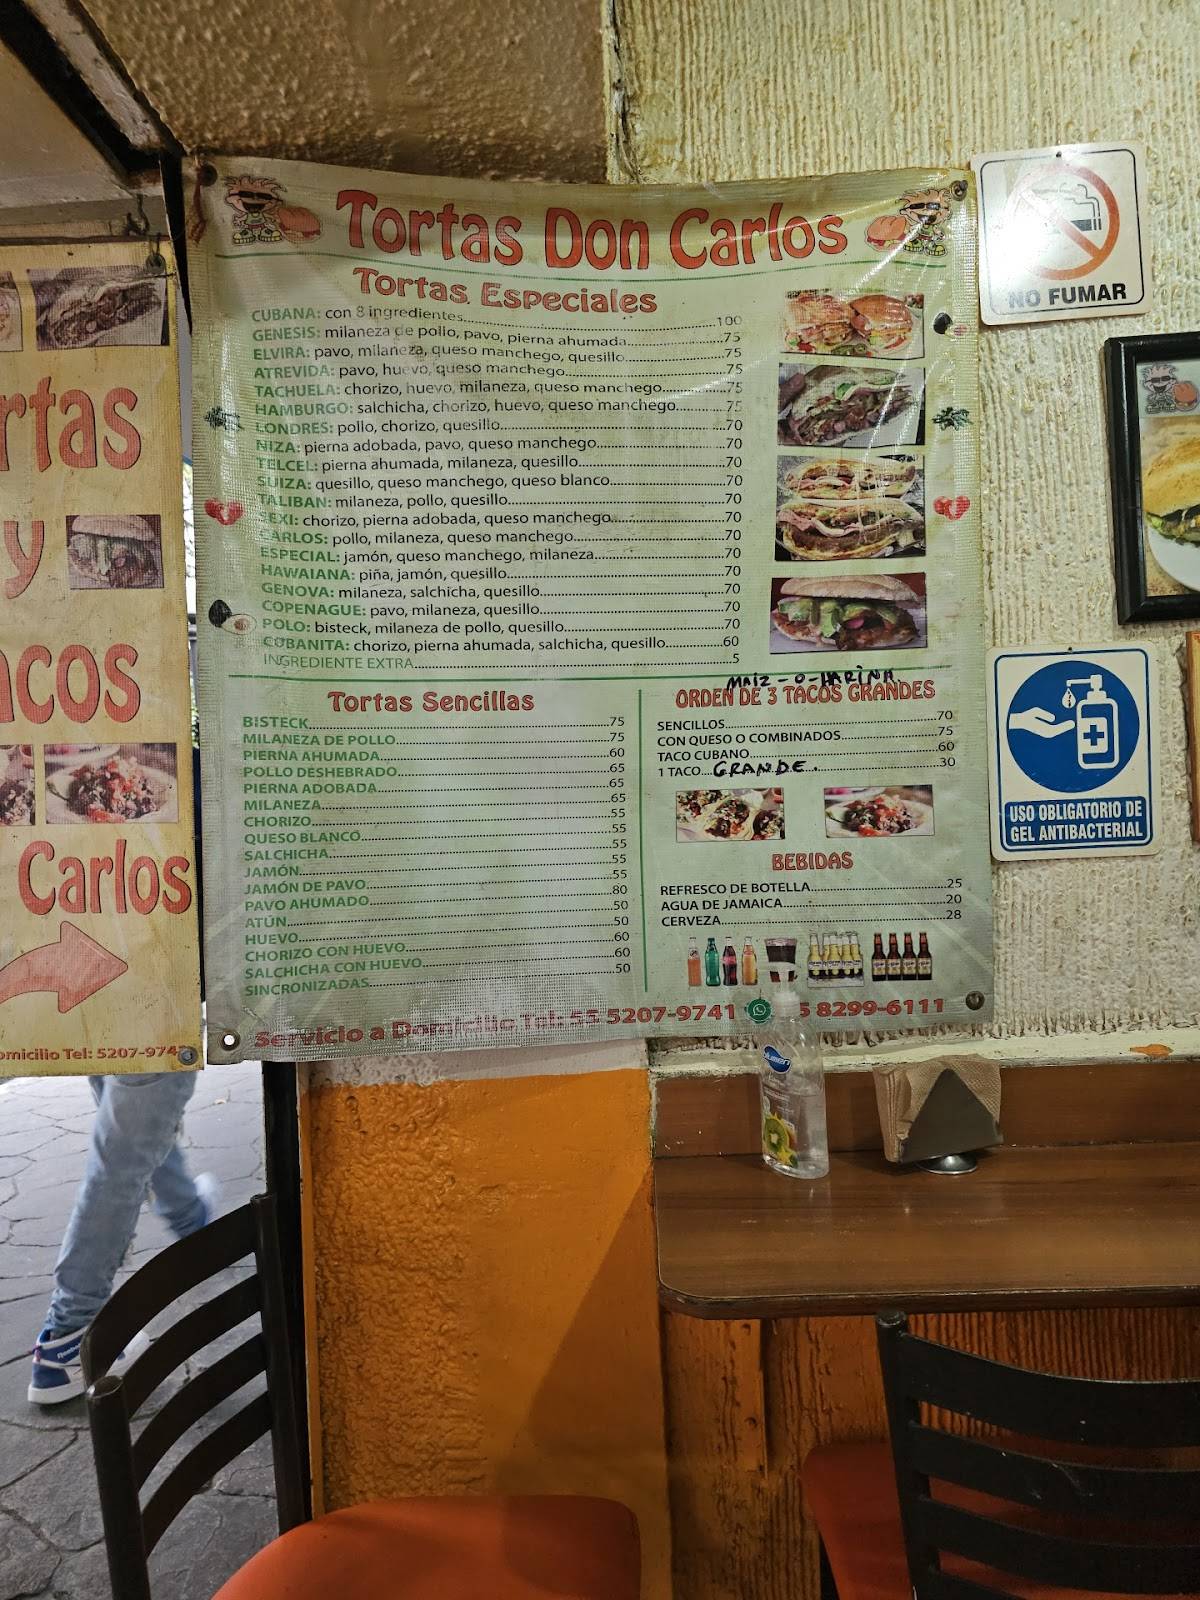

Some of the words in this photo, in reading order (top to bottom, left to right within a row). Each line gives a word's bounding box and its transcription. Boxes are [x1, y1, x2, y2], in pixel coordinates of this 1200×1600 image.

[336, 190, 524, 266] Tortas
[545, 207, 650, 270] Don
[669, 203, 848, 269] Carlos
[481, 281, 657, 313] Especiales
[1008, 289, 1041, 308] NO
[1048, 283, 1127, 304] FUMAR
[252, 307, 321, 322] CUBANA:
[326, 308, 351, 319] con
[356, 306, 365, 317] 8
[369, 306, 463, 321] ingredientes
[717, 315, 742, 326] 100
[256, 403, 352, 416] HAMBURGO:
[358, 401, 428, 414] salchicha,
[433, 400, 490, 412] chorizo,
[495, 399, 543, 411] huevo,
[548, 400, 593, 412] queso
[599, 399, 676, 413] manchego
[4, 521, 44, 599] y
[261, 548, 340, 562] ESPECIAL:
[344, 551, 392, 565] jamón,
[397, 551, 440, 564] queso
[445, 549, 525, 563] manchego,
[530, 549, 593, 560] milaneza
[725, 548, 741, 558] 70
[261, 564, 355, 580] HAWAIANA:
[360, 569, 393, 582] piña,
[397, 568, 446, 582] jamón,
[451, 567, 507, 581] quesillo
[725, 566, 741, 576] 70
[262, 582, 334, 598] GENOVA:
[339, 587, 406, 599] milaneza,
[410, 586, 479, 598] salchicha,
[484, 585, 539, 599] quesillo
[725, 583, 740, 594] 70
[263, 600, 365, 616] COPENAGUE:
[370, 606, 408, 618] pavo,
[412, 604, 479, 616] milaneza,
[484, 603, 539, 617] quesillo
[724, 601, 740, 612] 70
[263, 619, 310, 632] POLO:
[315, 621, 370, 635] bisteck,
[375, 621, 438, 633] milaneza
[443, 622, 460, 633] de
[465, 621, 504, 635] pollo,
[509, 621, 564, 635] quesillo
[724, 619, 740, 629] 70
[264, 653, 362, 669] INGREDIENTE
[368, 658, 413, 669] EXTRA
[733, 653, 739, 663] 5
[328, 691, 412, 712] Tortas
[423, 690, 535, 712] Sencillas
[676, 688, 734, 708] ORDEN
[740, 688, 761, 705] DE
[768, 687, 777, 705] 3
[783, 684, 842, 704] TACOS
[848, 680, 935, 702] GRANDES
[243, 716, 308, 729] BISTECK
[610, 717, 624, 726] 75
[658, 720, 725, 731] SENCILLOS
[937, 711, 953, 720] 70
[243, 733, 320, 745] MILANEZA
[325, 736, 343, 745] DE
[348, 735, 395, 745] POLLO
[610, 732, 625, 742] 75
[658, 737, 685, 746] CON
[689, 734, 732, 746] QUESO
[736, 734, 745, 743] O
[750, 731, 841, 743] COMBINADOS
[938, 726, 953, 736] 75
[244, 751, 298, 761] PIERNA
[302, 751, 380, 761] AHUMADA
[610, 748, 624, 757] 60
[658, 752, 691, 761] TACO
[695, 749, 749, 760] CUBANO
[939, 742, 954, 751] 60
[244, 767, 292, 778] POLLO
[298, 766, 397, 777] DESHEBRADO
[610, 763, 624, 772] 65
[659, 768, 663, 776] 1
[668, 767, 700, 776] TACO
[941, 757, 956, 766] 30
[244, 783, 298, 794] PIERNA
[302, 783, 377, 793] ADOBADA
[610, 778, 624, 788] 65
[244, 800, 321, 810] MILANEZA
[611, 793, 625, 803] 65
[1010, 805, 1035, 823] USO
[1039, 801, 1121, 821] OBLIGATORIO
[1126, 800, 1142, 817] DE
[244, 816, 311, 827] CHORIZO
[611, 808, 625, 818] 55
[244, 832, 296, 845] QUESO
[301, 831, 360, 843] BLANCO
[612, 824, 626, 833] 55
[1011, 826, 1035, 842] GEL
[1039, 822, 1143, 841] ANTIBACTERIAL
[244, 849, 328, 861] SALCHICHA
[612, 839, 627, 848] 55
[244, 864, 299, 878] JAMÓN
[612, 854, 626, 864] 55
[772, 851, 854, 870] BEBIDAS
[18, 839, 192, 915] Carlos
[244, 881, 298, 895] JAMÓN
[303, 882, 322, 892] DE
[326, 879, 366, 891] PAVO
[612, 870, 627, 879] 55
[660, 884, 726, 895] REFRESCO
[730, 884, 747, 893] DE
[752, 882, 810, 892] BOTELLA
[947, 879, 962, 888] 25
[245, 900, 285, 912] PAVO
[290, 896, 369, 910] AHUMADO
[613, 885, 628, 895] 80
[662, 901, 698, 911] AGUA
[703, 900, 719, 910] DE
[723, 899, 782, 909] JAMAICA
[946, 894, 962, 904] 20
[245, 915, 287, 928] ATÚN
[614, 901, 628, 910] 50
[662, 916, 720, 926] CERVEZA
[946, 910, 962, 919] 28
[245, 932, 298, 945] HUEVO
[614, 916, 629, 926] 50
[245, 949, 312, 962] CHORIZO
[317, 946, 348, 957] CON
[353, 942, 405, 955] HUEVO
[615, 932, 629, 941] 60
[245, 963, 330, 979] SALCHICHA
[335, 961, 366, 972] CON
[370, 958, 422, 970] HUEVO
[615, 948, 630, 957] 60
[245, 978, 369, 996] SINCRONIZADAS
[615, 964, 630, 973] 50
[255, 1025, 363, 1048] Servicio
[370, 1027, 385, 1040] a
[571, 1010, 600, 1024] 55
[607, 1004, 735, 1024] 5207-9741
[816, 998, 944, 1017] 8299-6111
[64, 1048, 92, 1060] Tel:
[97, 1045, 185, 1059] 5207-974
